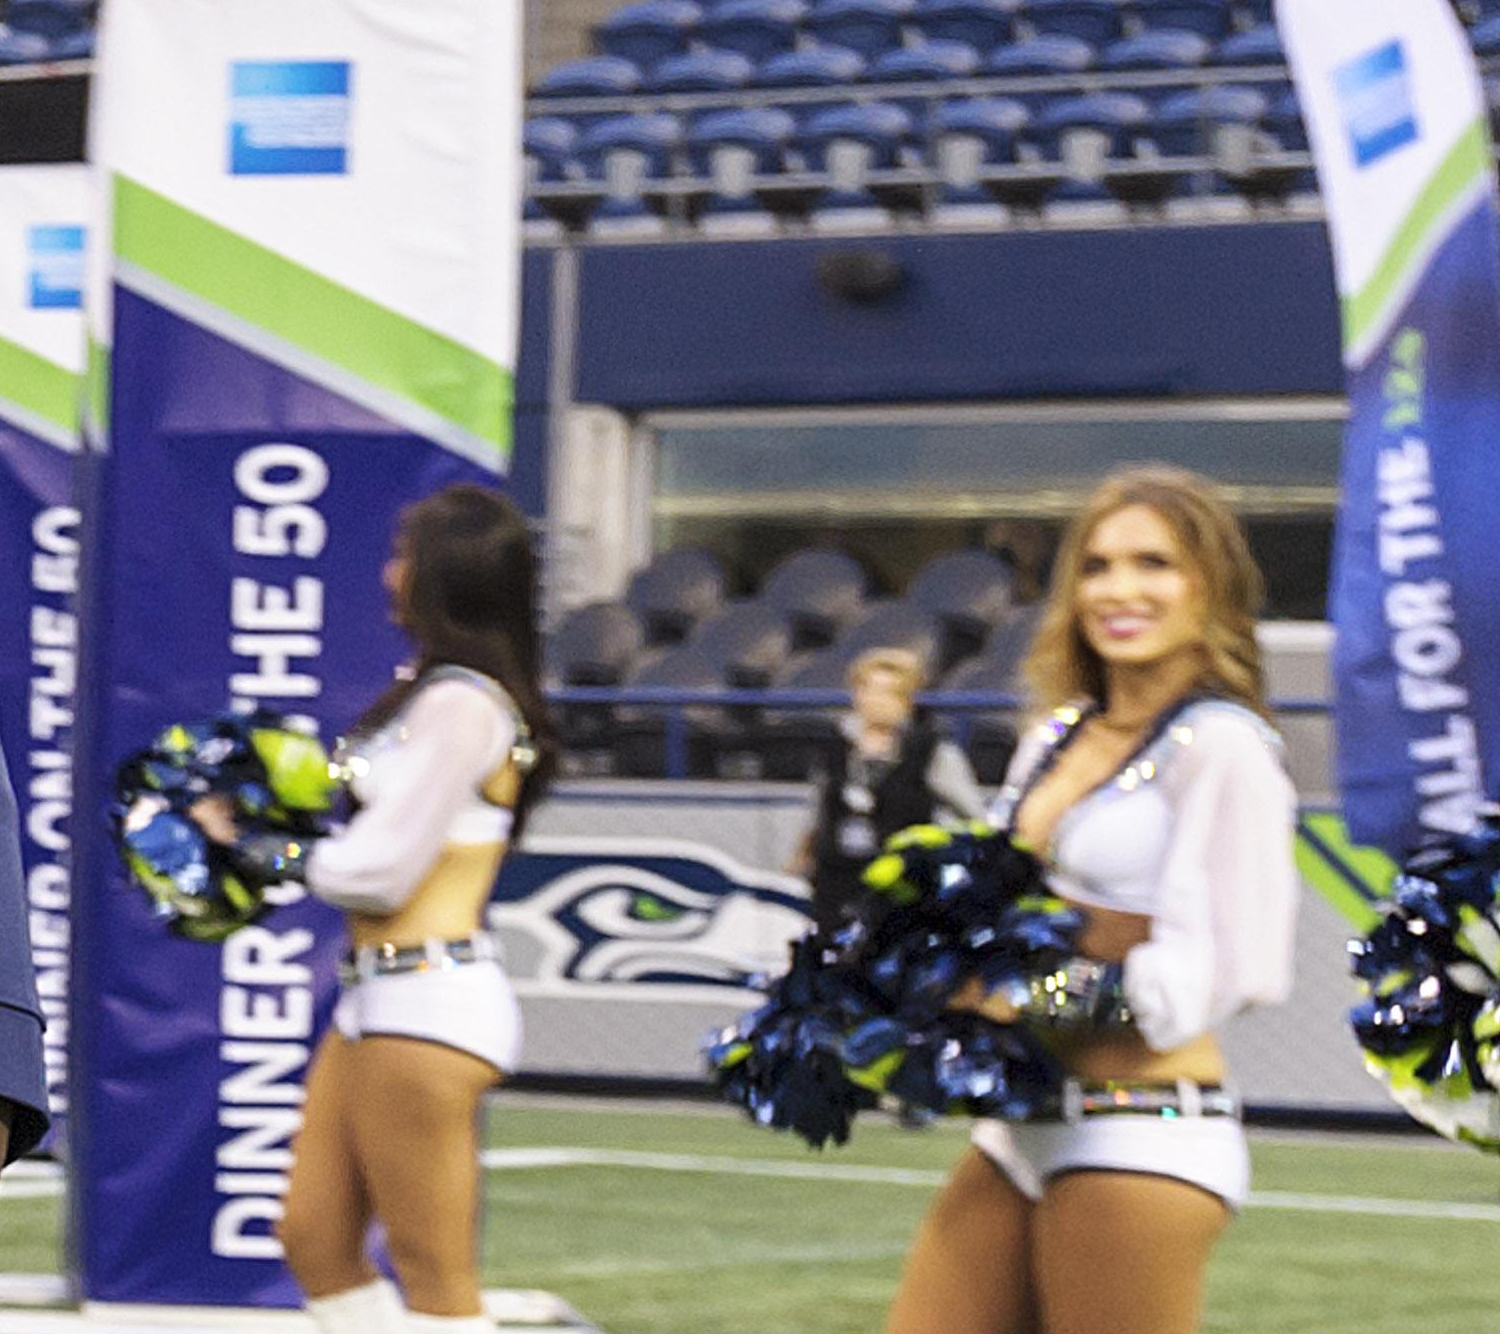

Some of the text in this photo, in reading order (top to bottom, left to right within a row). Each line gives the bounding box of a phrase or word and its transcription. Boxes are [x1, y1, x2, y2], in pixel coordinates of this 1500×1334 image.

[232, 443, 330, 560] 50
[1383, 580, 1470, 712] FOR
[211, 926, 316, 1261] DINNER
